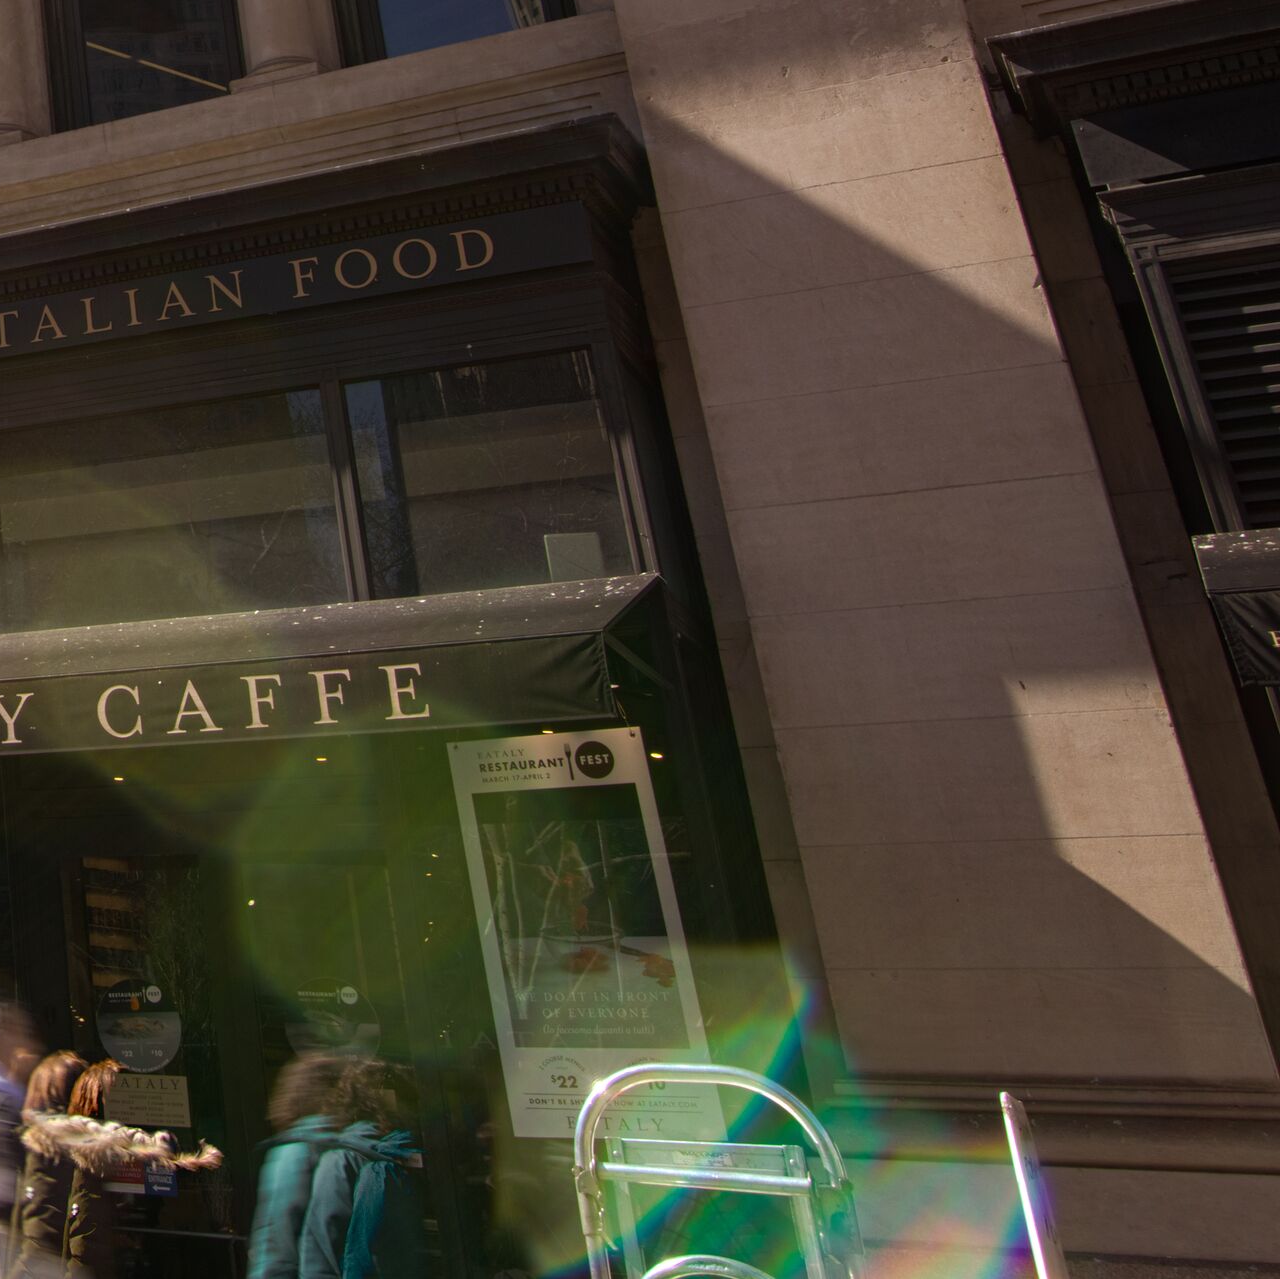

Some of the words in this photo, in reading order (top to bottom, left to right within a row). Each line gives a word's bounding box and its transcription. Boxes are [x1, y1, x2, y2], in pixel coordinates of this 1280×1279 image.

[289, 228, 495, 299] FOOD
[97, 662, 431, 740] CAFFE
[477, 748, 525, 760] EATALY
[479, 757, 564, 773] RESTAURANT
[579, 754, 609, 766] FEST
[482, 775, 509, 783] MARCH
[544, 991, 566, 1002] DO
[593, 992, 609, 1002] IN
[617, 991, 671, 1002] FRONT
[568, 1007, 650, 1018] EVERYONE
[551, 1075, 579, 1088] $22
[529, 1098, 555, 1106] DON'T
[558, 1098, 567, 1106] BE
[567, 1115, 665, 1132] ETALY
